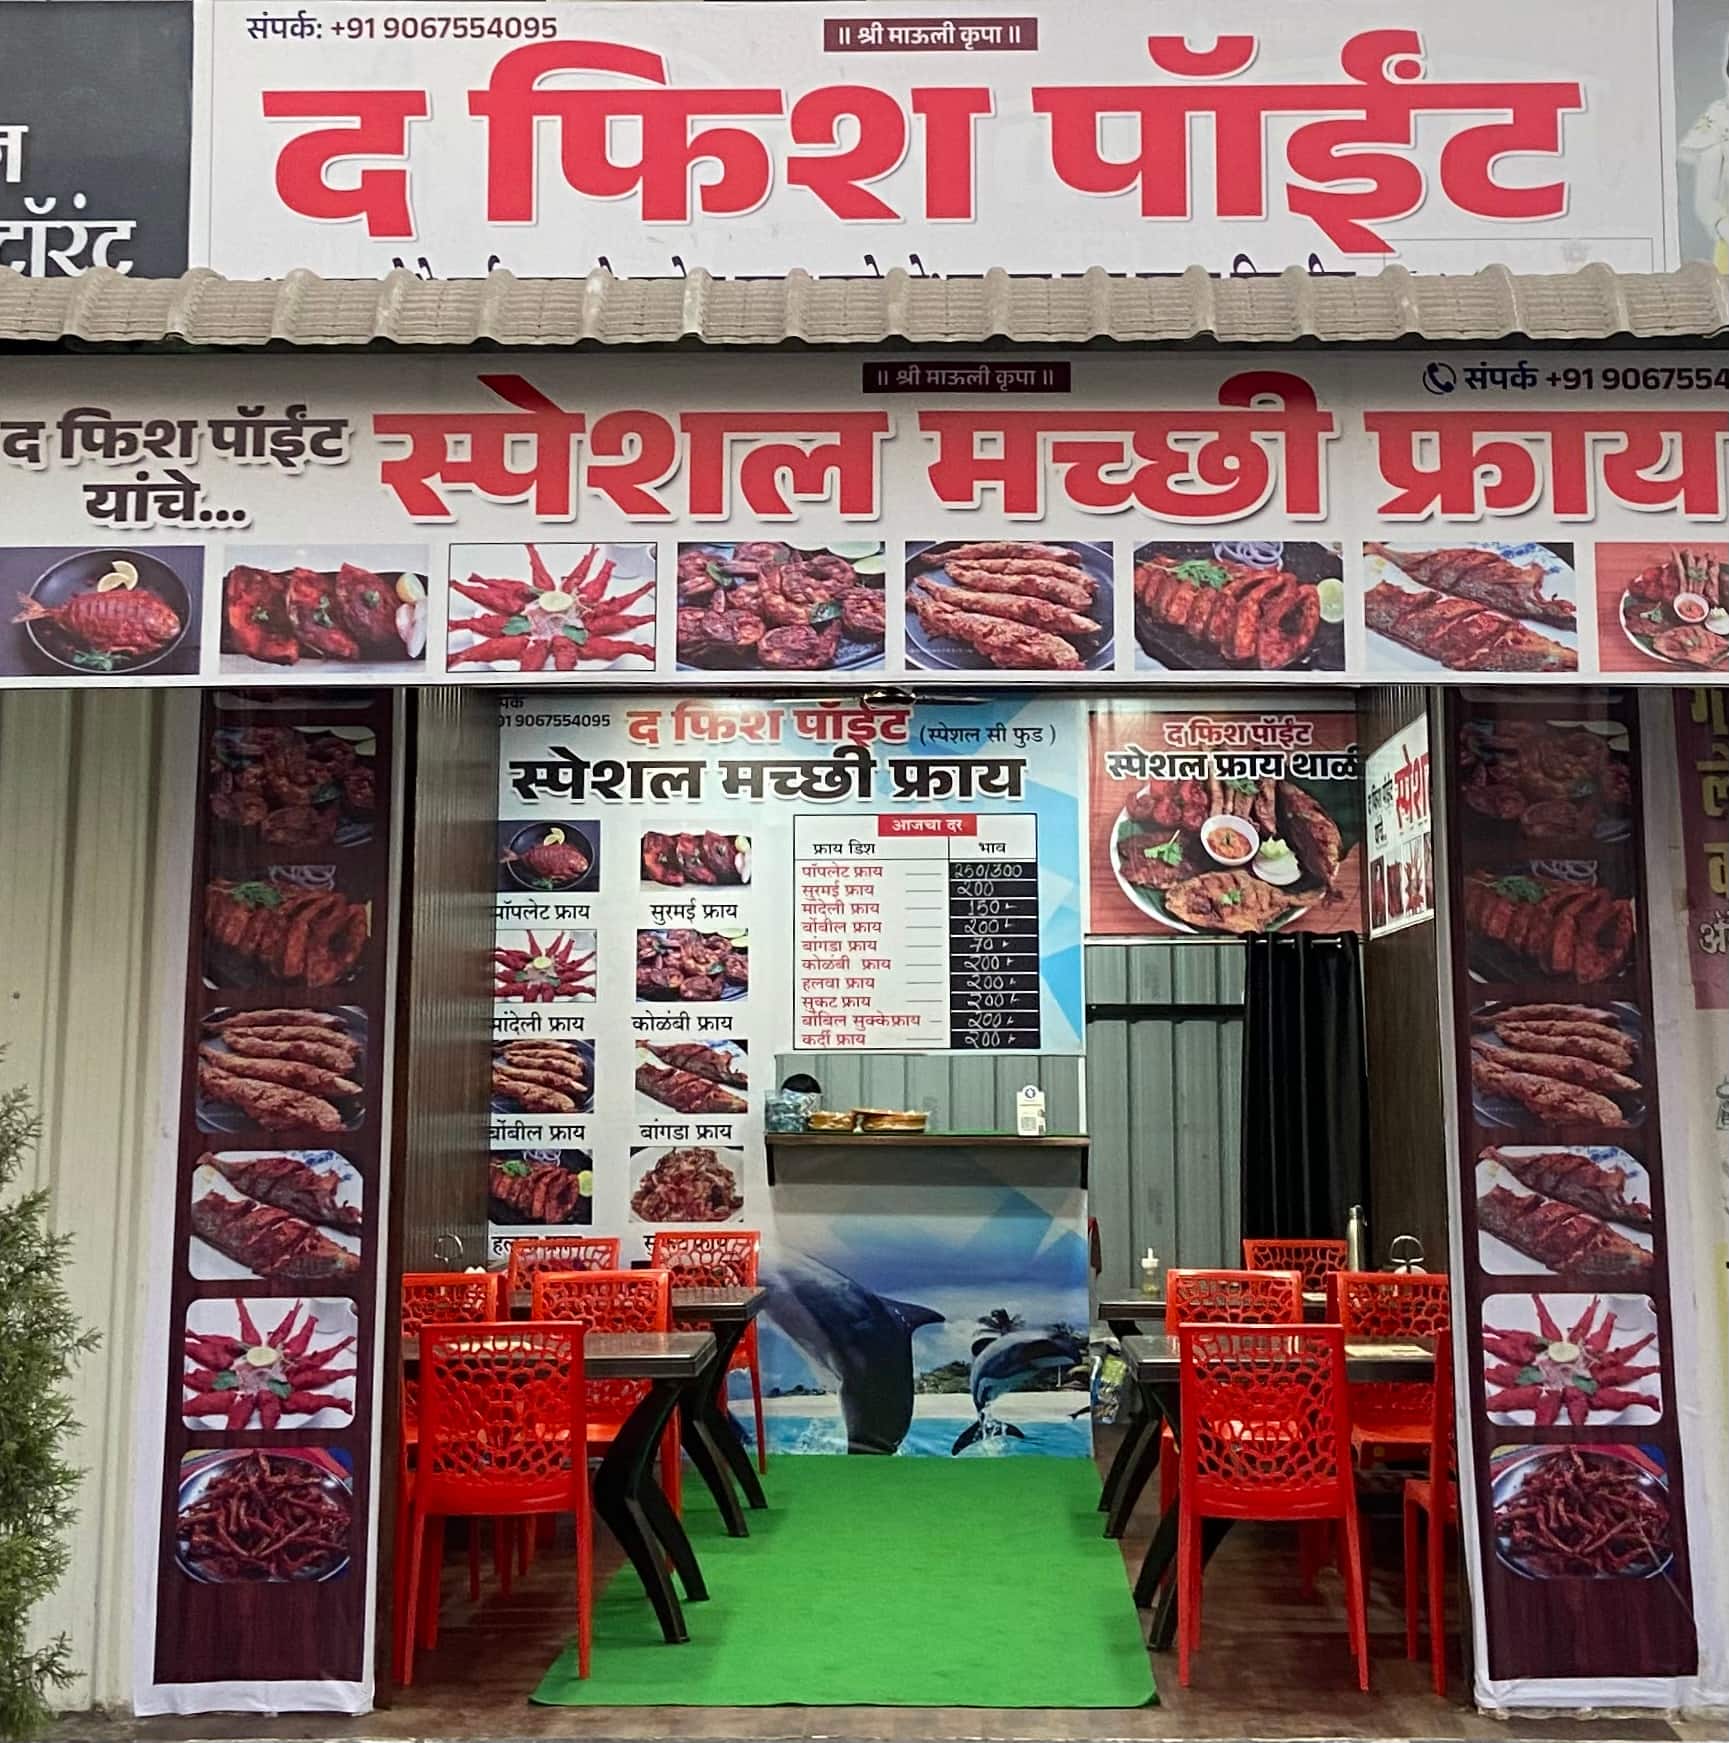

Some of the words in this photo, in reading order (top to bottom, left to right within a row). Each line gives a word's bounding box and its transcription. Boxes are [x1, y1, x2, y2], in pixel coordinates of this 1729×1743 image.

[246, 10, 322, 39] संपर्क:
[331, 17, 374, 39] +91
[383, 17, 557, 39] 9067554095
[857, 21, 885, 45] श्री
[887, 21, 956, 45] माऊली
[957, 26, 1002, 50] कृपा
[263, 91, 427, 237] द
[468, 40, 990, 221] फिश
[1031, 29, 1580, 254] पॉईंट
[896, 364, 920, 386] श्री
[925, 365, 991, 386] माऊली
[995, 369, 1037, 392] कृपा
[1462, 360, 1539, 390] संपर्क
[1546, 368, 1593, 390] +91
[0, 421, 45, 463] द
[56, 407, 199, 459] फिश
[373, 374, 891, 516] स्पेशल
[917, 371, 1331, 517] मच्छी
[1363, 410, 1729, 518] फ्राय
[515, 714, 610, 728] 9067554095
[627, 711, 661, 745] द
[671, 700, 784, 741] फिश
[986, 722, 1006, 743] सी
[1011, 727, 1043, 748] फुड
[1165, 724, 1187, 746] द
[1190, 718, 1248, 745] फिश
[1107, 747, 1207, 779] स्पेशल
[1214, 754, 1284, 779] फ्राय
[510, 746, 706, 800] स्पेशल
[718, 744, 876, 801] मच्छी
[888, 759, 1025, 801] फ्राय
[892, 820, 941, 832] आजचा
[947, 820, 963, 833] दर
[813, 842, 842, 855] फ्राय
[849, 839, 876, 855] डिश
[979, 842, 1006, 854] भाव
[853, 867, 883, 878] फ्राय
[845, 885, 875, 897] फ्राय
[554, 905, 591, 920] फ्राय
[649, 896, 697, 925] सुरमई
[701, 904, 739, 921] फ्राय
[850, 903, 880, 914] फ्राय
[853, 922, 882, 933] फ्राय
[848, 941, 878, 952] फ्राय
[861, 960, 891, 970] फ्राय
[844, 978, 875, 989] फ्राय
[841, 997, 871, 1008] फ्राय
[548, 1016, 585, 1032] फ्राय
[631, 1010, 691, 1032] कोळंबी
[696, 1016, 734, 1032] फ्राय
[836, 1034, 866, 1045] फ्राय
[549, 1125, 586, 1141] फ्राय
[639, 1118, 690, 1141] बांगडा
[695, 1125, 733, 1141] फ्राय
